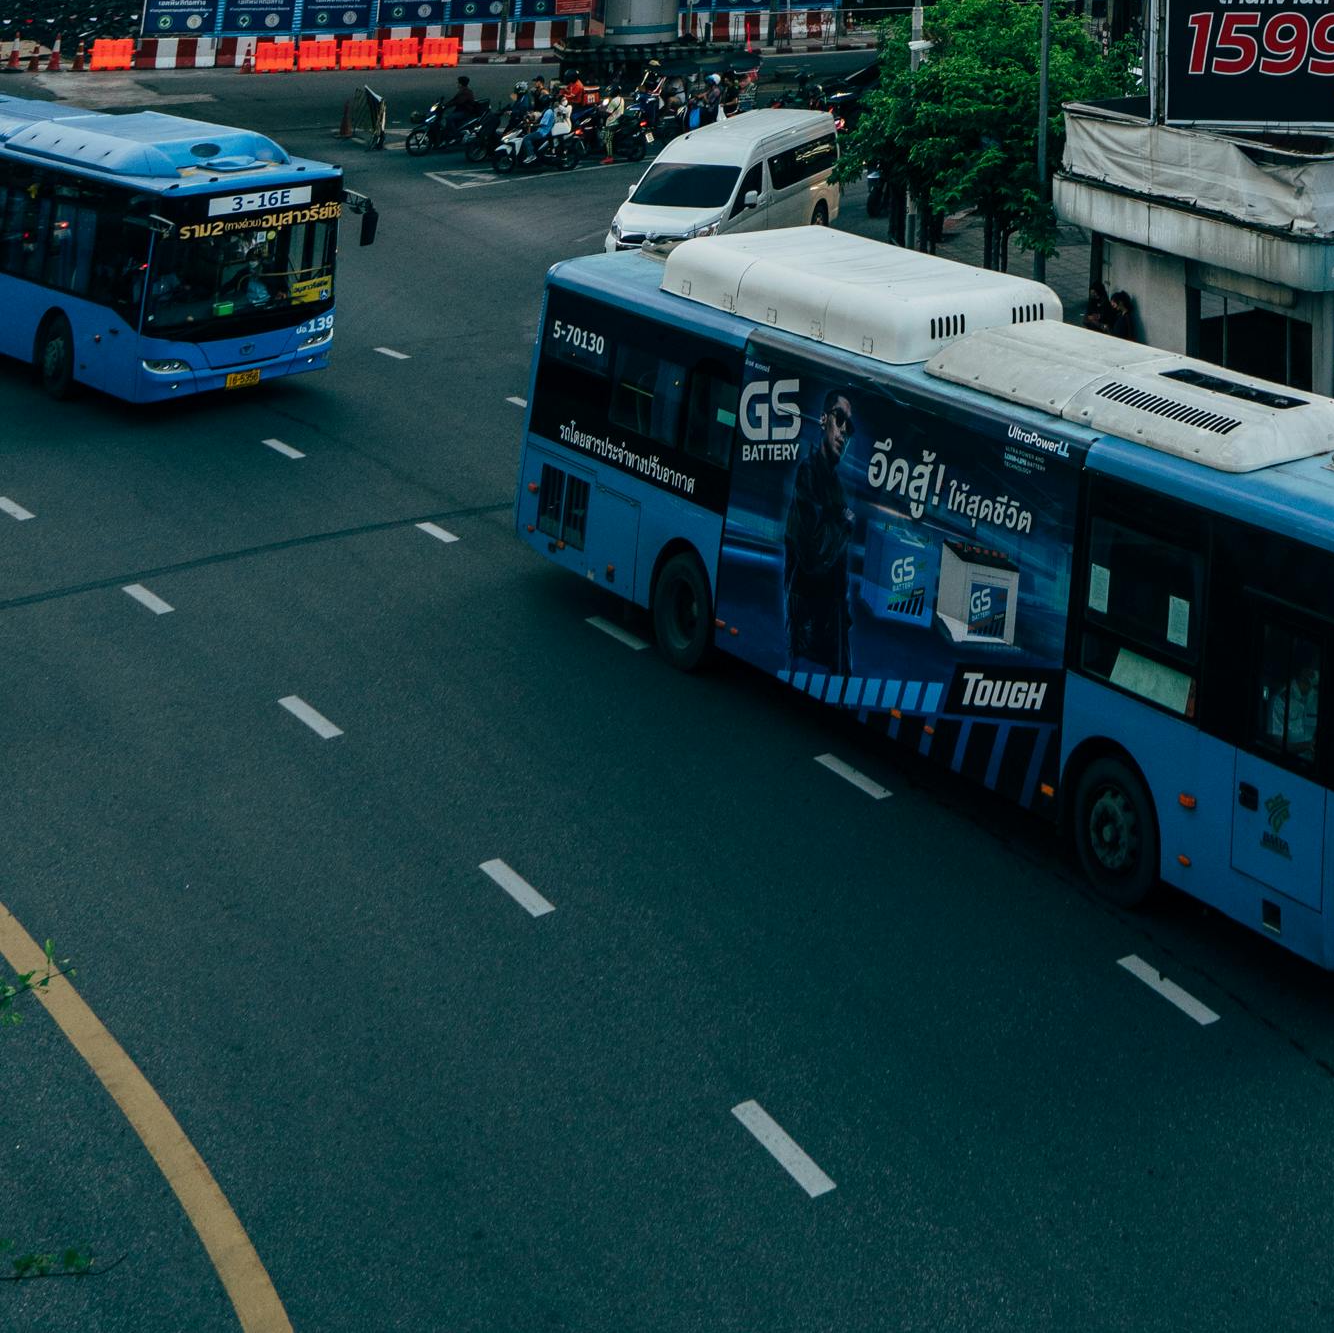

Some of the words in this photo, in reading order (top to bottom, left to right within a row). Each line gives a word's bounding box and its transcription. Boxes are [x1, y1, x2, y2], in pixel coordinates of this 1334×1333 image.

[232, 190, 291, 212] 3-16E
[180, 220, 224, 240] ราม2
[308, 315, 333, 333] 139
[552, 319, 605, 356] 5-70130
[739, 378, 802, 441] GS
[560, 420, 696, 495] รถโดยสารประจำทางปรับอากาศ
[742, 443, 800, 462] BATTERY
[867, 437, 946, 518] อึดสู้!
[947, 480, 1032, 534] ให้สุดชีวิต
[891, 556, 915, 584] GS
[970, 588, 992, 614] GS
[962, 671, 1048, 711] TOUGH
